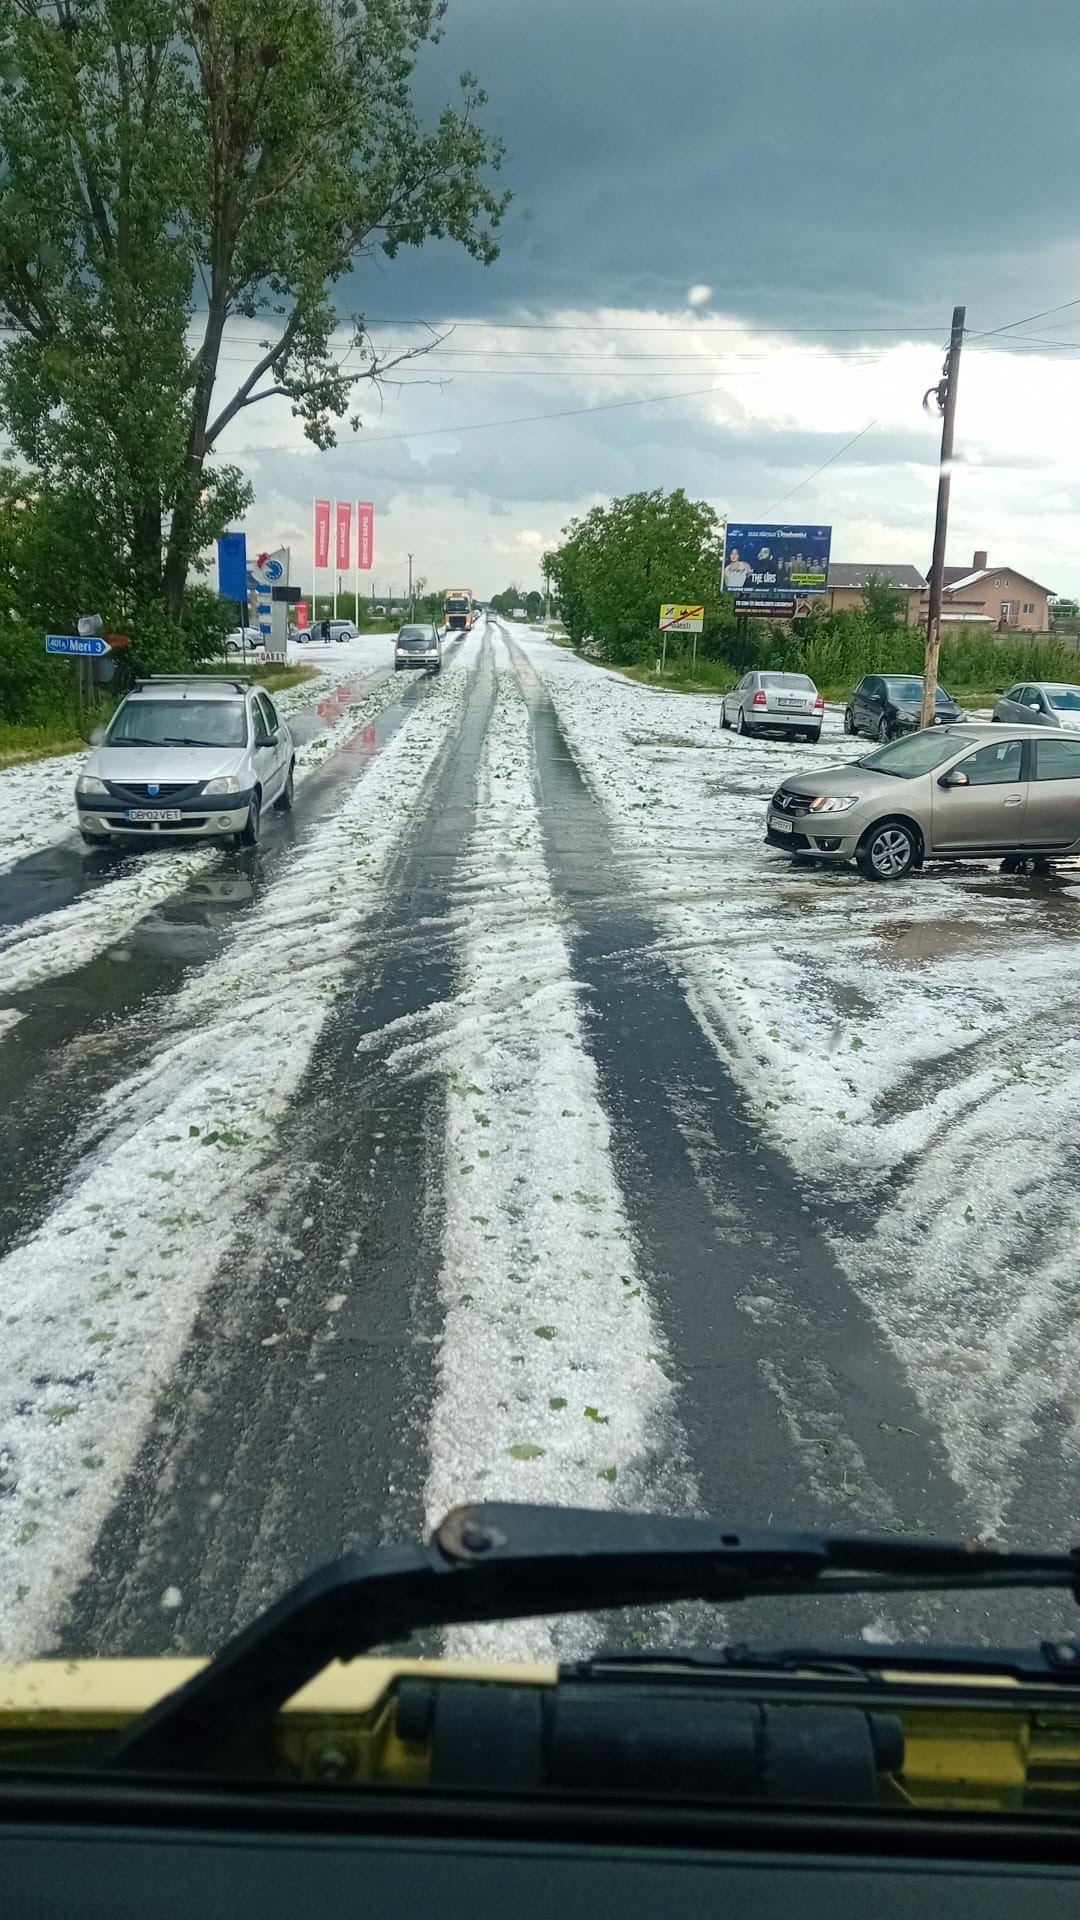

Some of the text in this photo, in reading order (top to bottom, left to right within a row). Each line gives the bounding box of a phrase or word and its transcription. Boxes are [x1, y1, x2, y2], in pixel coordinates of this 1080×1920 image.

[751, 573, 763, 584] THE
[70, 639, 91, 652] Meri
[95, 642, 102, 652] 3
